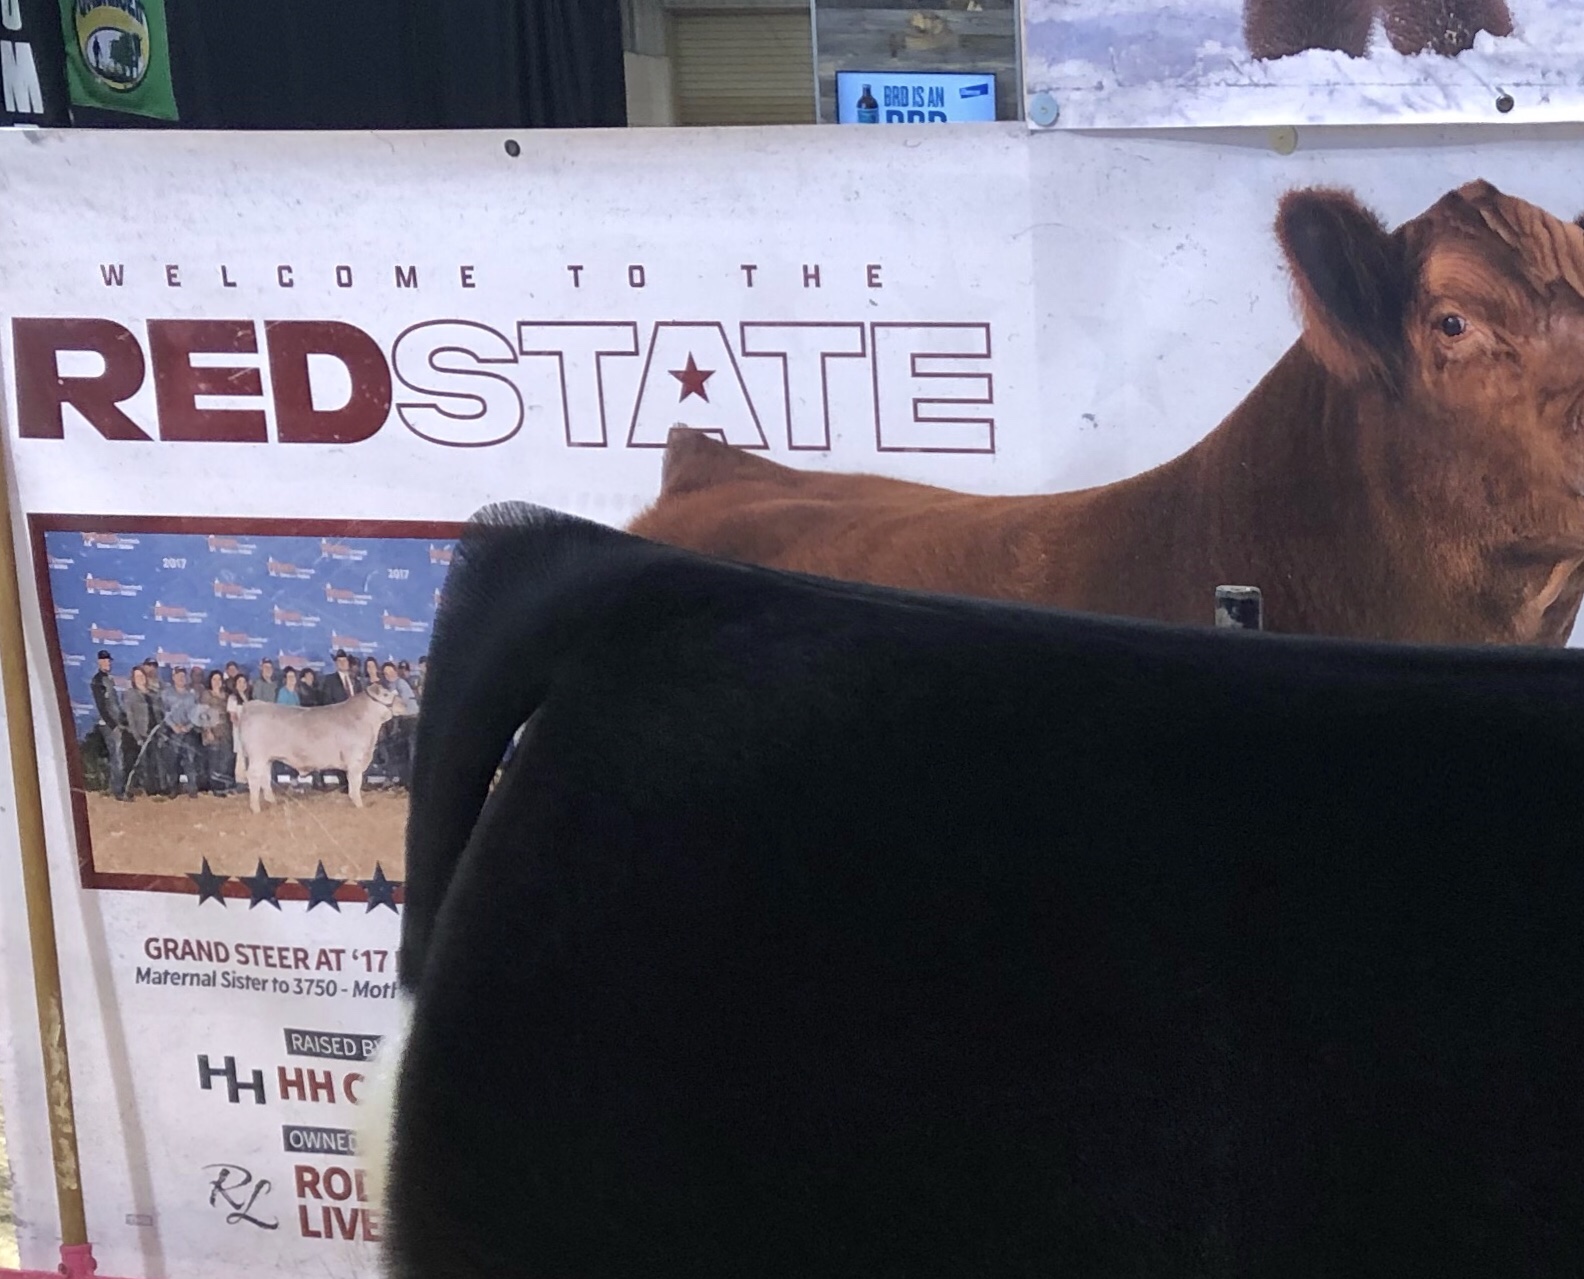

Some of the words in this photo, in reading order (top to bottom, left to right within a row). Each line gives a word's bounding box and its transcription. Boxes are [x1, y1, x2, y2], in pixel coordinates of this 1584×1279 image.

[884, 86, 909, 107] BRD
[912, 86, 924, 107] IS
[927, 86, 945, 108] AN
[100, 264, 476, 289] WELCOME
[567, 264, 646, 288] TO
[740, 264, 883, 288] THE
[162, 558, 187, 569] 2017
[387, 568, 410, 580] 2017
[144, 937, 230, 963] GRAND
[234, 943, 310, 970] STEER
[315, 948, 346, 972] AT
[135, 966, 217, 988] Maternal
[221, 970, 268, 992] Sister
[271, 977, 290, 994] to
[293, 977, 338, 997] 3750
[291, 1033, 357, 1057] RAISED
[277, 1065, 336, 1104] HH
